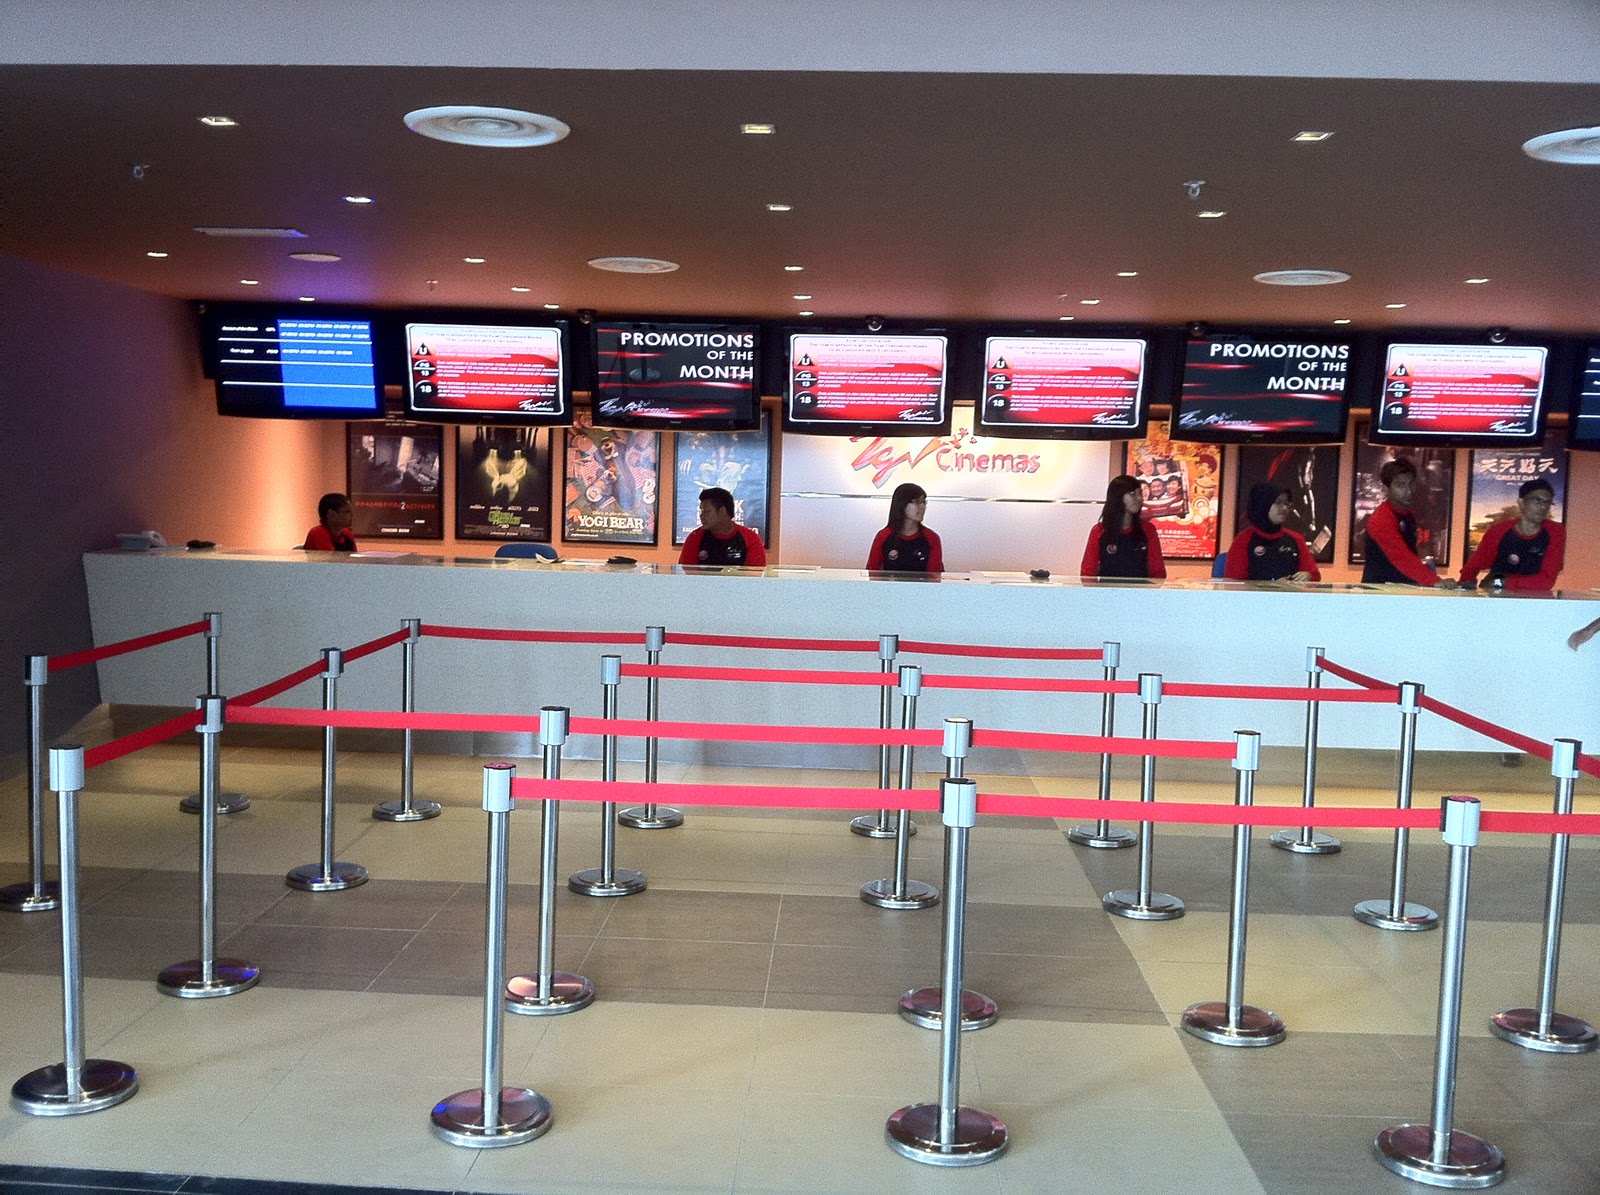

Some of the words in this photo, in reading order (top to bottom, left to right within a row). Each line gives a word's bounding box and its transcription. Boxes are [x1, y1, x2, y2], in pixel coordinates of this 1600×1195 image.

[621, 332, 754, 348] PROMOTIONS
[707, 350, 726, 360] OF
[730, 351, 754, 361] THE
[1210, 343, 1349, 359] PROMOTIONS
[679, 365, 754, 379] MONTH
[1298, 361, 1318, 371] OF
[1323, 362, 1347, 372] THE
[420, 385, 432, 393] 18
[1267, 376, 1345, 391] MONTH
[800, 396, 812, 404] 18
[936, 448, 1041, 474] Cinemas
[400, 501, 406, 510] 2
[578, 515, 609, 527] YOGI
[609, 516, 645, 529] BEAR
